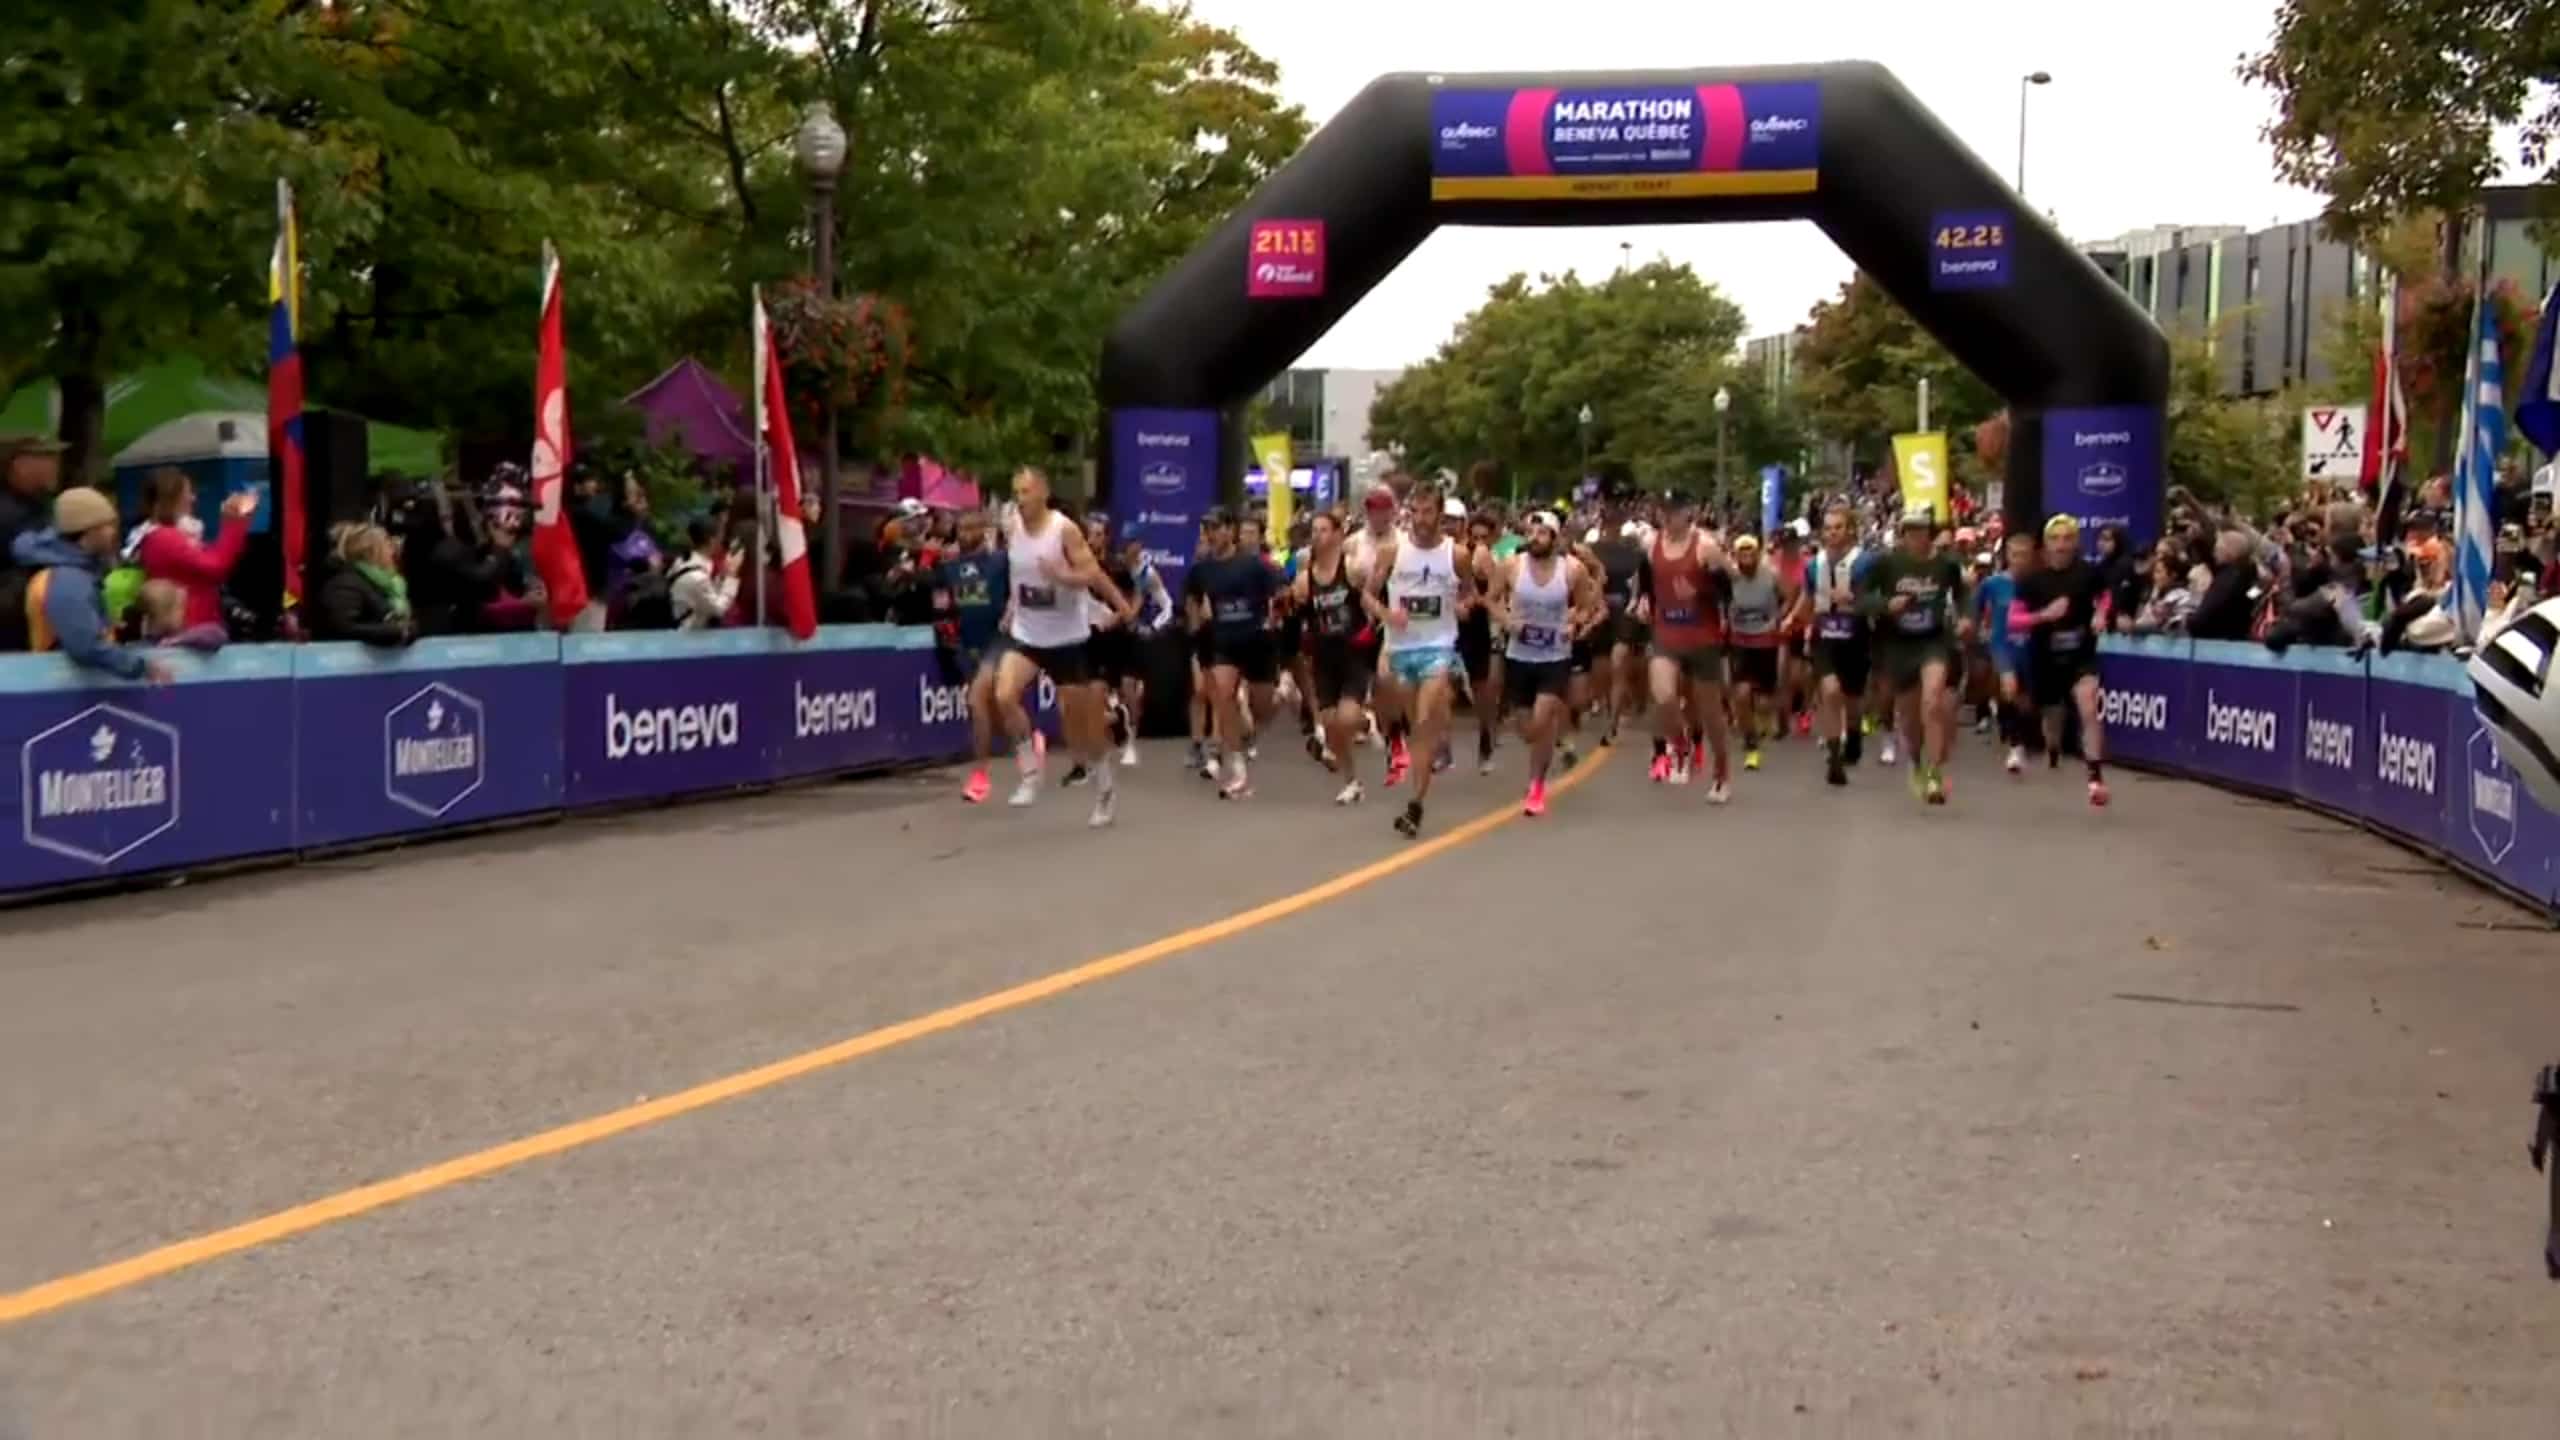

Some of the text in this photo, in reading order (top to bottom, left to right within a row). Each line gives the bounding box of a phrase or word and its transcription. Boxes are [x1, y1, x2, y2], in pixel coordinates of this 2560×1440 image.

[1554, 98, 1692, 122] MARATHON
[1554, 121, 1691, 142] BENEVA QUÉBEC
[1255, 228, 1298, 254] 21.1
[1936, 225, 1988, 249] 42.2
[2074, 430, 2131, 447] beneva
[1909, 451, 1937, 488] S
[606, 693, 738, 759] beneva
[795, 680, 877, 738] beneva
[2206, 689, 2277, 751] beneva
[2304, 702, 2354, 769] beneva
[2378, 713, 2436, 795] beneva
[39, 766, 166, 817] MONTELLIER
